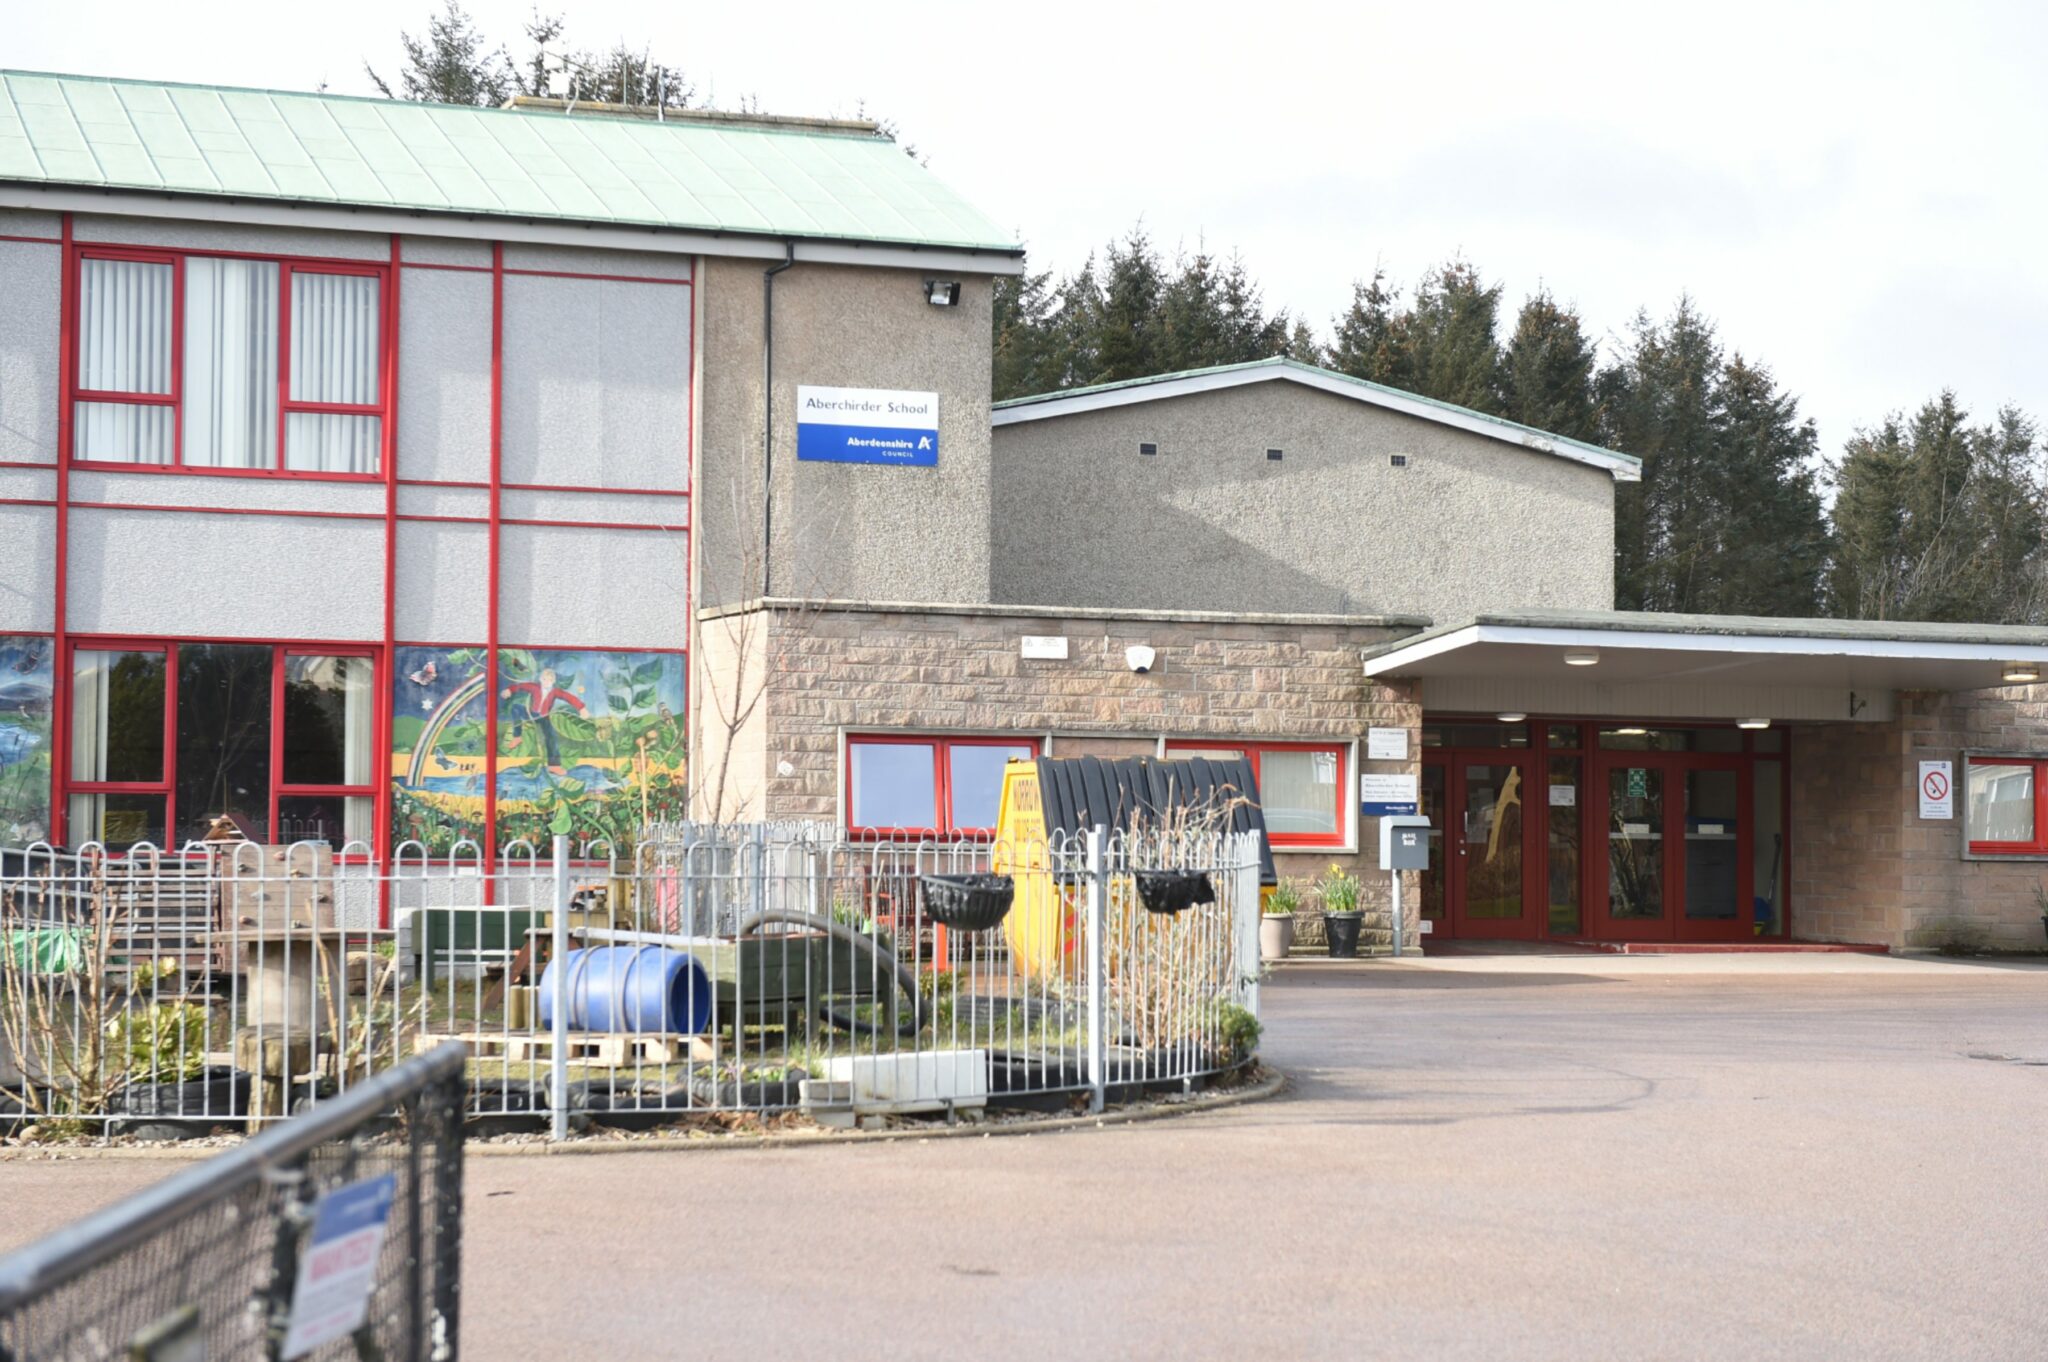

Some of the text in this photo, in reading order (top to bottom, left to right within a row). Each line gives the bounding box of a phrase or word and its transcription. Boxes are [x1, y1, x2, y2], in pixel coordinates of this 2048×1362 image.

[806, 398, 928, 414] Aberchirder School
[847, 437, 913, 449] Aberdeenshire
[882, 450, 914, 458] COUNCIL
